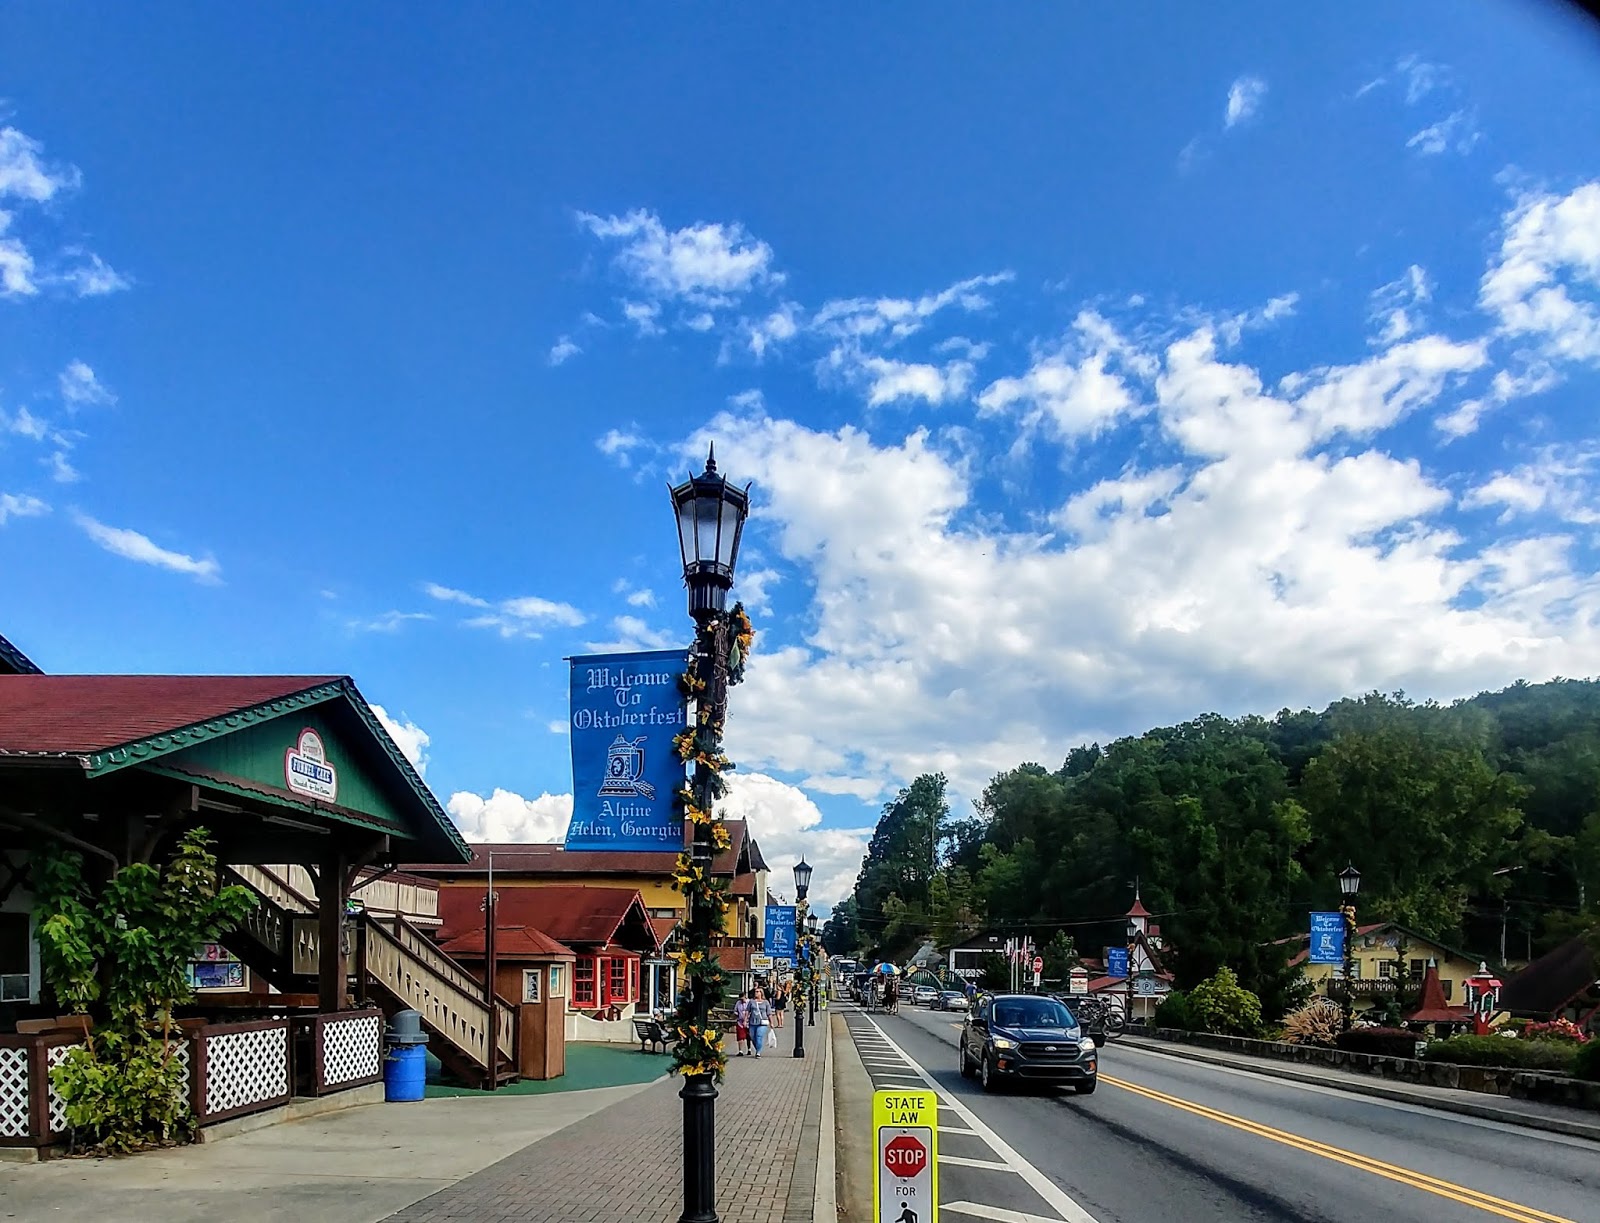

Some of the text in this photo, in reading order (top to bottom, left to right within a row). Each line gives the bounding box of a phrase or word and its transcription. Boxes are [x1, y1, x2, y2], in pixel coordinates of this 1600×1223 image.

[587, 668, 670, 694] Welcome
[614, 687, 641, 708] To
[573, 706, 684, 730] Oktoberfest
[293, 760, 330, 781] FUNNEL CAKE
[598, 800, 652, 822] Alpine
[570, 820, 682, 841] Helen, Georgia
[885, 1097, 925, 1109] STATE
[891, 1112, 919, 1124] LAW
[887, 1149, 924, 1165] STOP
[895, 1187, 916, 1196] FOR
